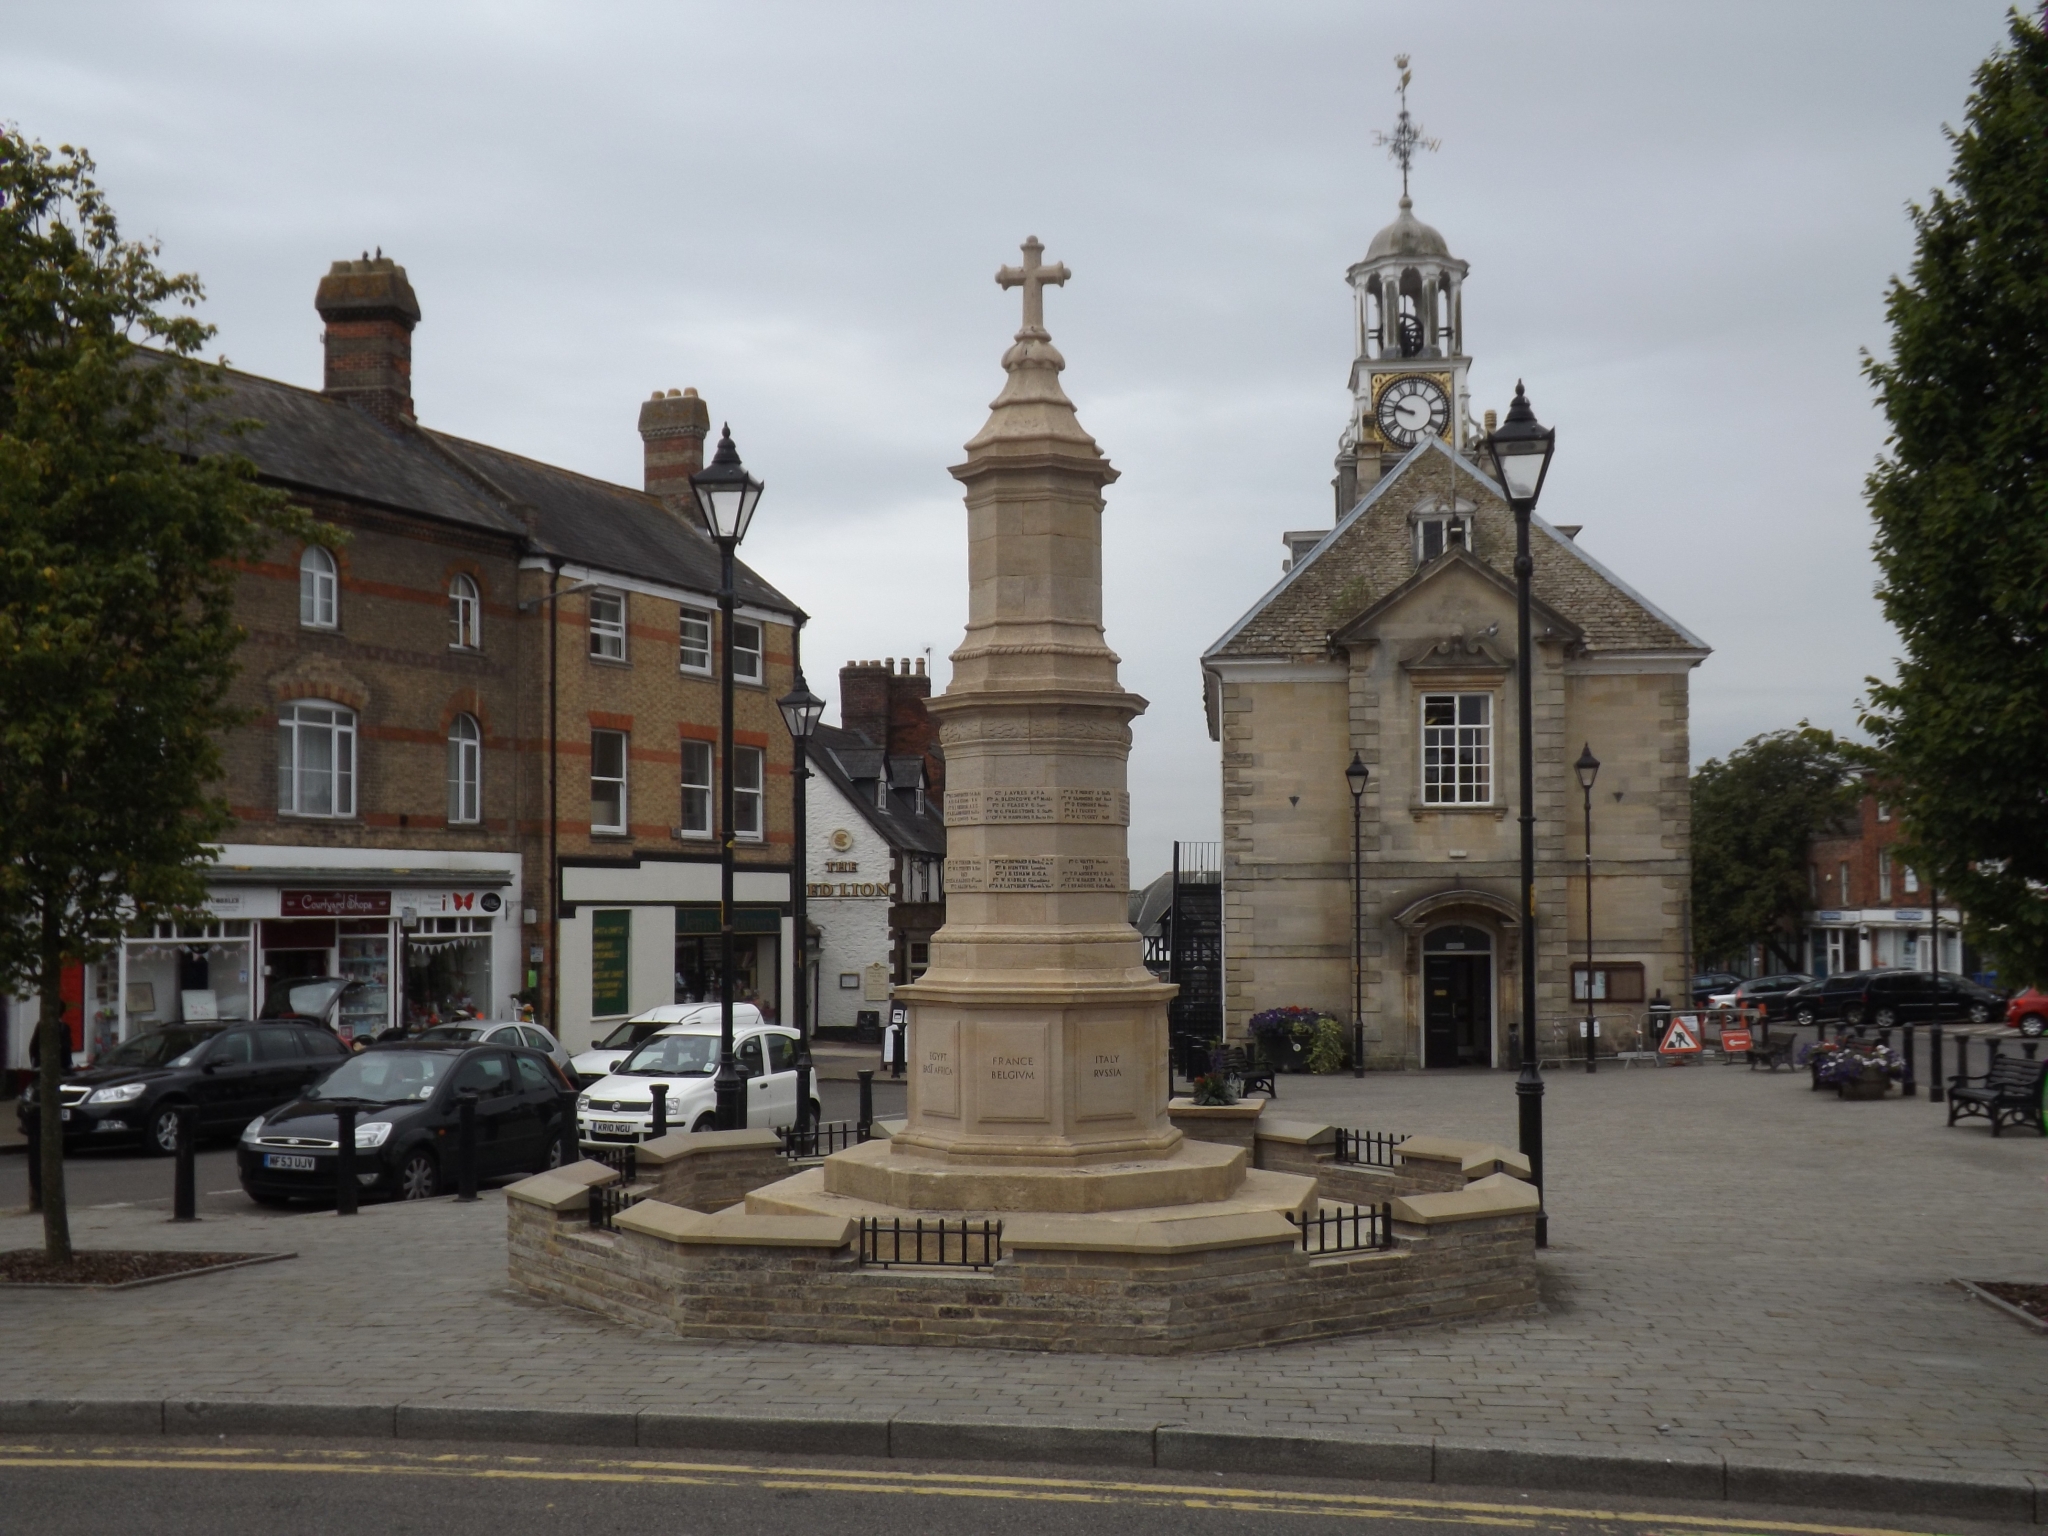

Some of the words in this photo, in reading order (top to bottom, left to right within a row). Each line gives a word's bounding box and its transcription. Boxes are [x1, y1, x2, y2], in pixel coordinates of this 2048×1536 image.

[825, 862, 858, 873] THE
[807, 883, 833, 897] ED
[839, 883, 890, 897] LION
[302, 894, 345, 912] Courtyard
[347, 894, 372, 912] Shops
[930, 1052, 947, 1061] EGYPT
[1096, 1055, 1120, 1063] ITALY
[992, 1057, 1034, 1066] FRANCE
[935, 1066, 953, 1076] AFRICA
[991, 1071, 1035, 1079] BELGIVM
[1094, 1069, 1122, 1077] RVSSIA
[615, 1124, 630, 1133] NGU
[295, 1158, 313, 1168] UJV
